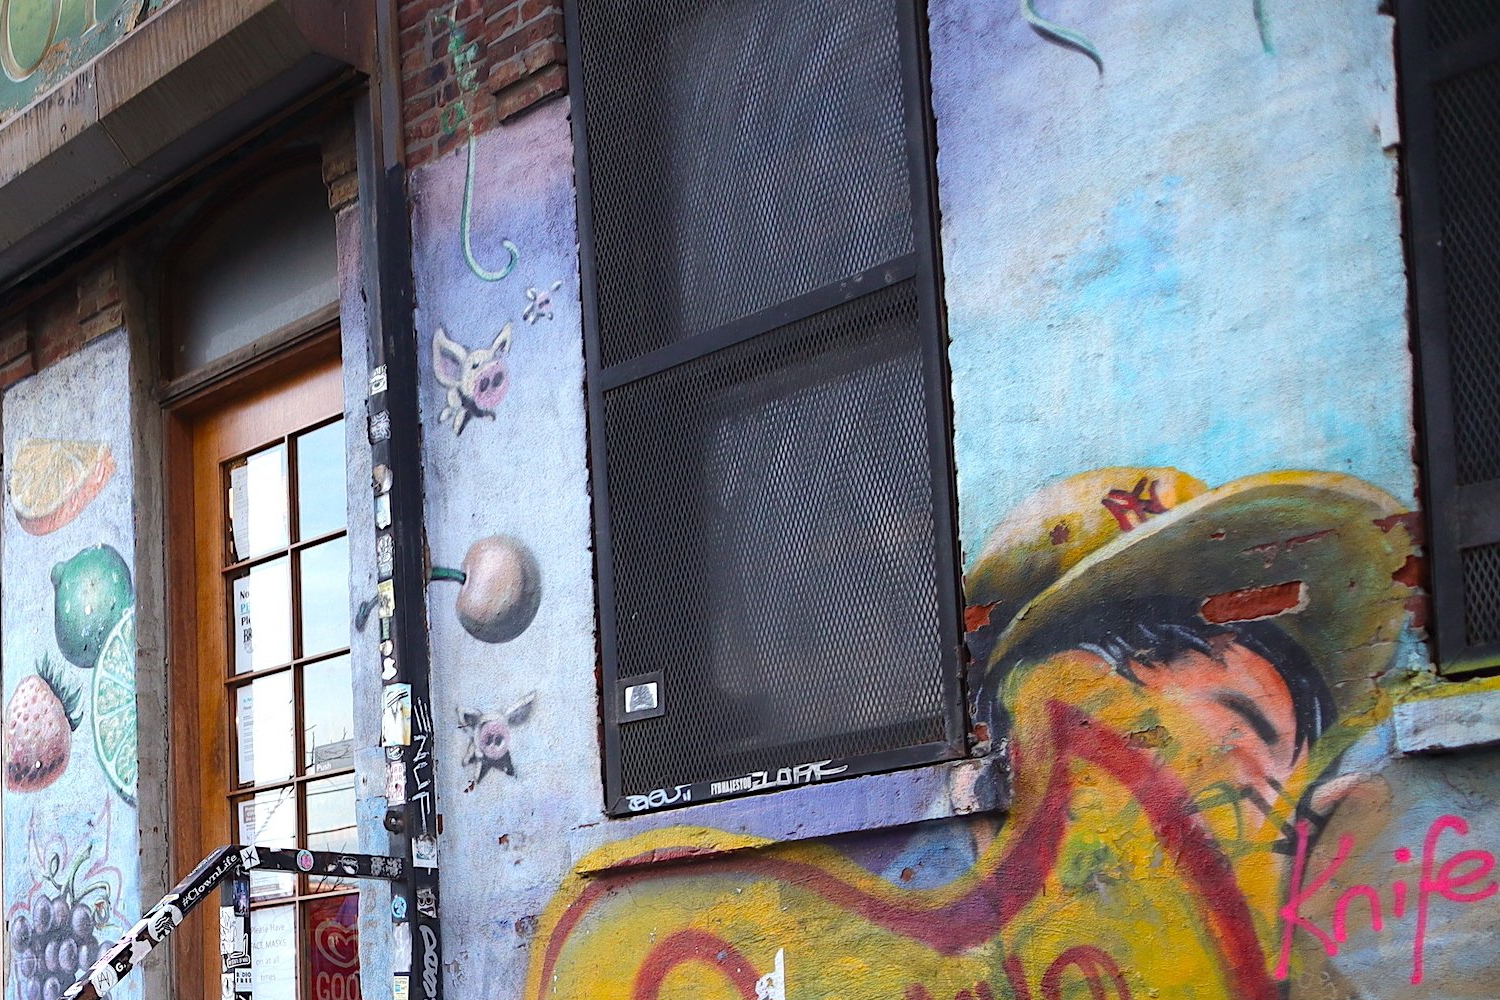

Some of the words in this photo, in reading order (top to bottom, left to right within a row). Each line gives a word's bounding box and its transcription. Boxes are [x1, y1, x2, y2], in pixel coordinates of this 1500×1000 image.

[316, 762, 332, 772] Push
[181, 854, 238, 907] #ClownLife
[1276, 813, 1500, 986] Knife
[251, 941, 264, 951] ACE
